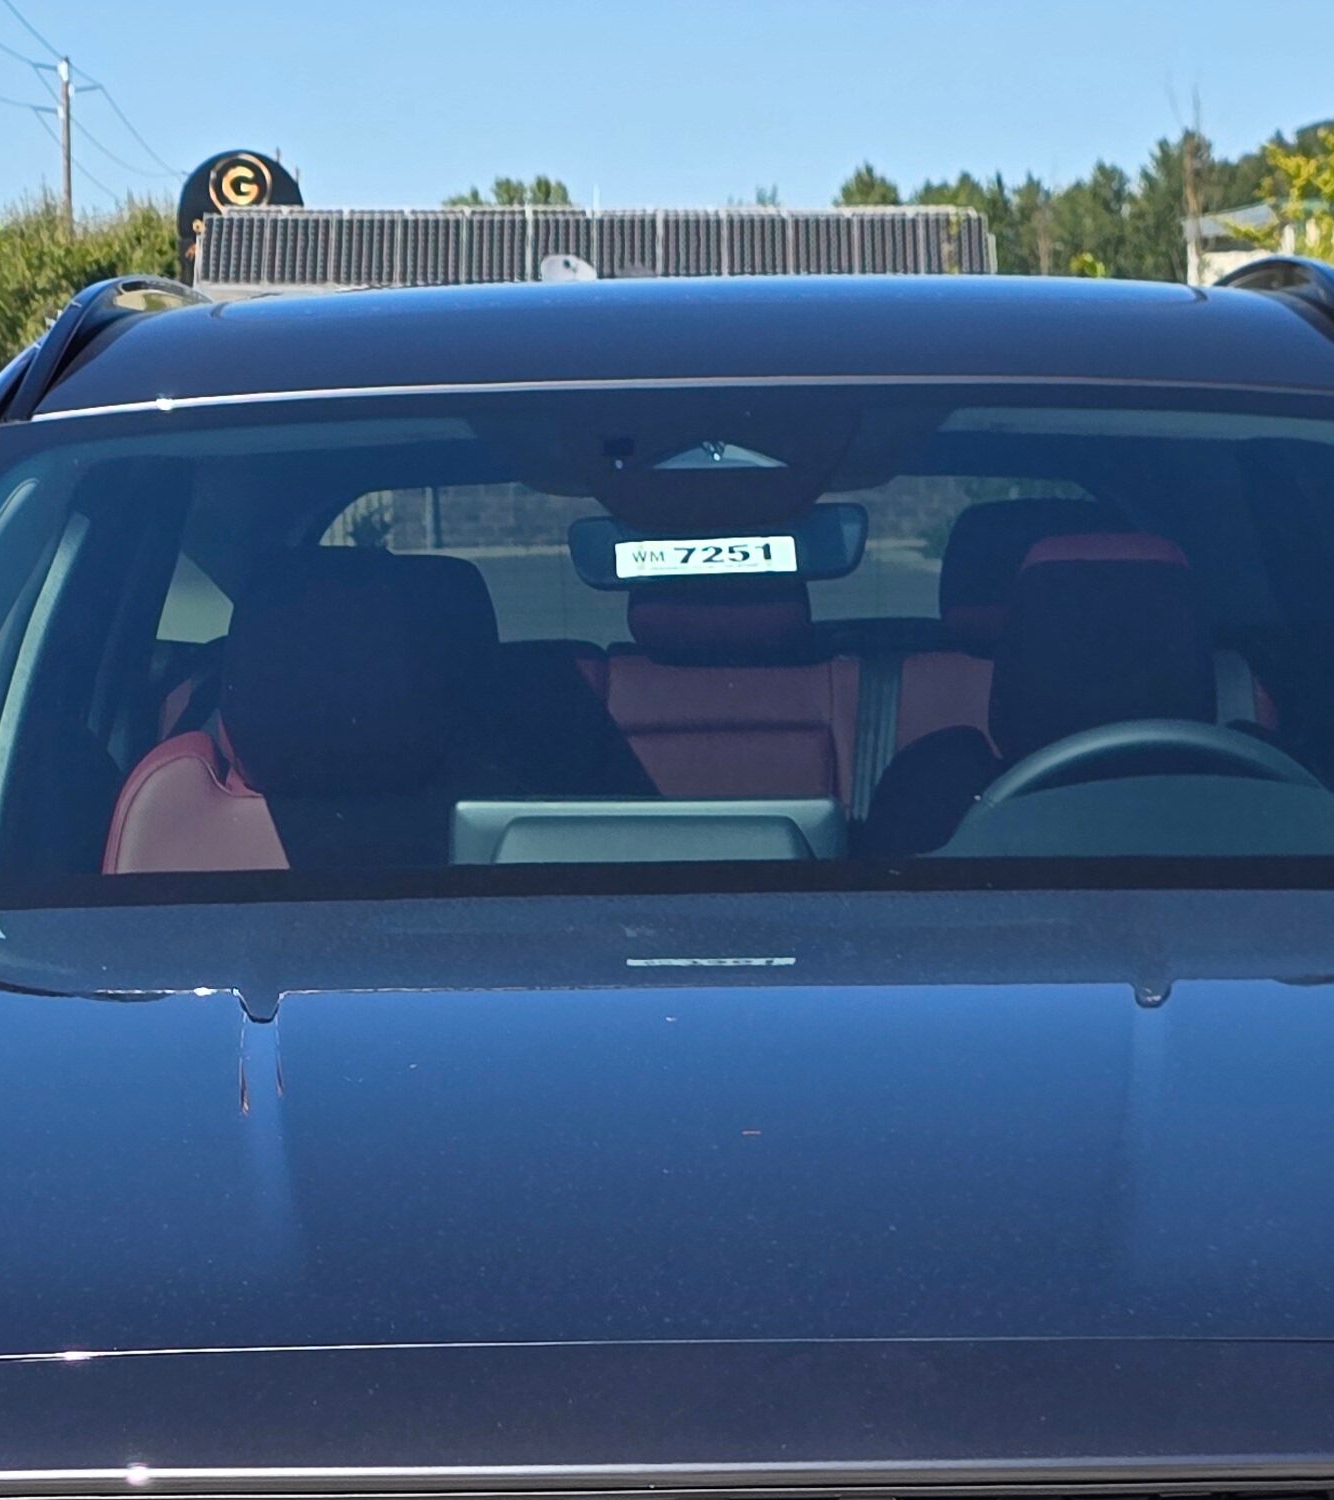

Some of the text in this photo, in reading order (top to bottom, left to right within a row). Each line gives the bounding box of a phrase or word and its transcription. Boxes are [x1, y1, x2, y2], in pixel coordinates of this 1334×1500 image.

[221, 165, 260, 206] G
[632, 543, 773, 565] WM 7251
